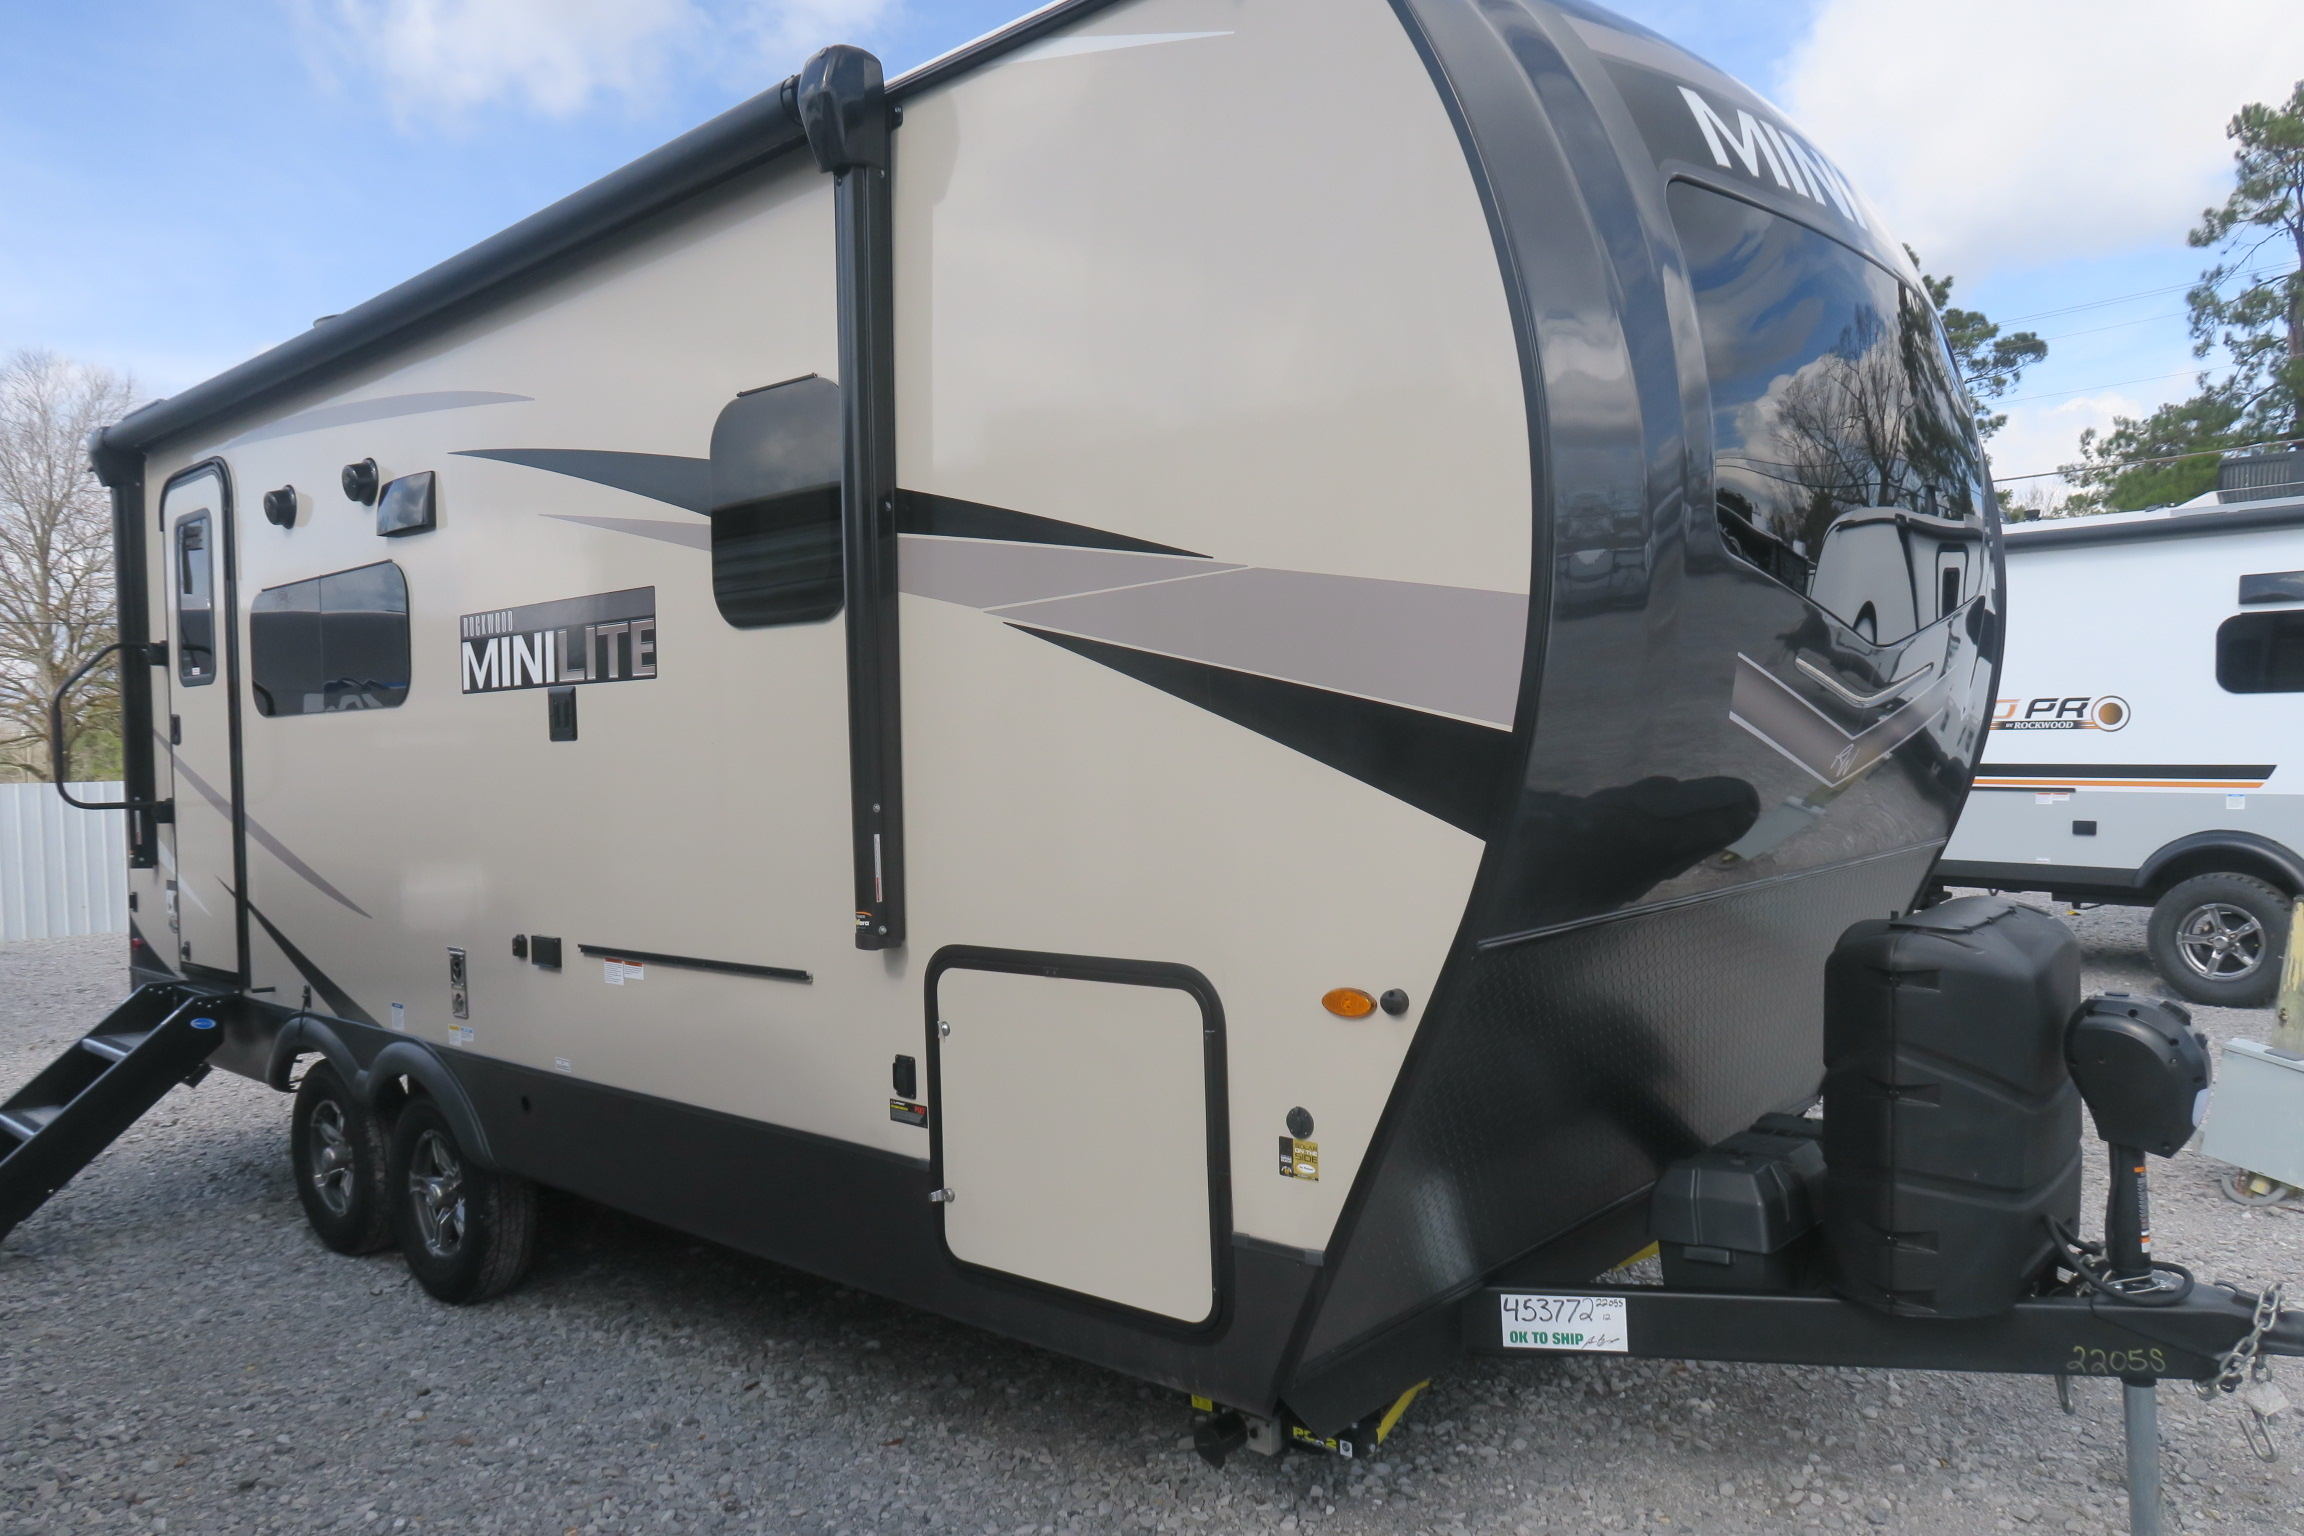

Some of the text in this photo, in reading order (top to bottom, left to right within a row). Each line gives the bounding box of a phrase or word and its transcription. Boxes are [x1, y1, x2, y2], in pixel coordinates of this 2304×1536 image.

[463, 610, 513, 638] ROCKWOOD
[2014, 721, 2074, 730] ROCKWOOD
[1294, 1143, 1318, 1152] SOLAR
[1295, 1153, 1318, 1164] SIDE
[1503, 1297, 1594, 1324] 453772
[1509, 1330, 1528, 1344] OK
[1531, 1331, 1548, 1344] TO
[1552, 1332, 1584, 1345] SHIP
